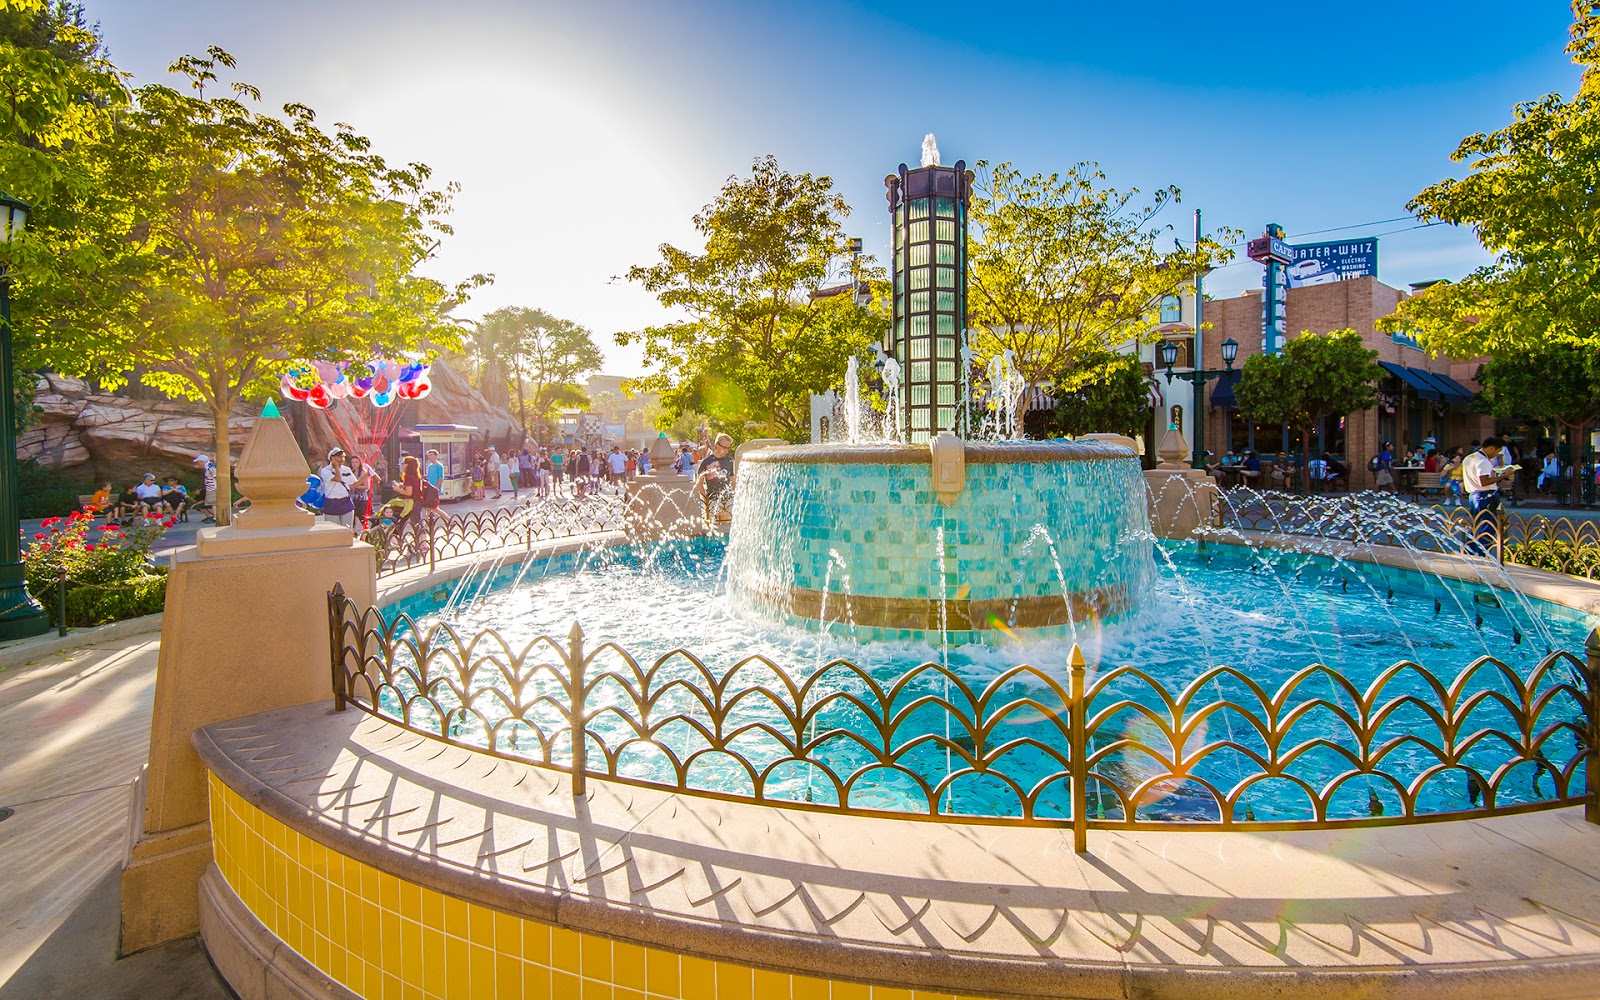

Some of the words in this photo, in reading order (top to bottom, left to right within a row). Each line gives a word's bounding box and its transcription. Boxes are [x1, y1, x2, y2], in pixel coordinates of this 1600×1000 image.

[1274, 243, 1292, 257] CAFE
[1342, 257, 1367, 265] ELECTRIC
[1342, 263, 1366, 271] WASHING
